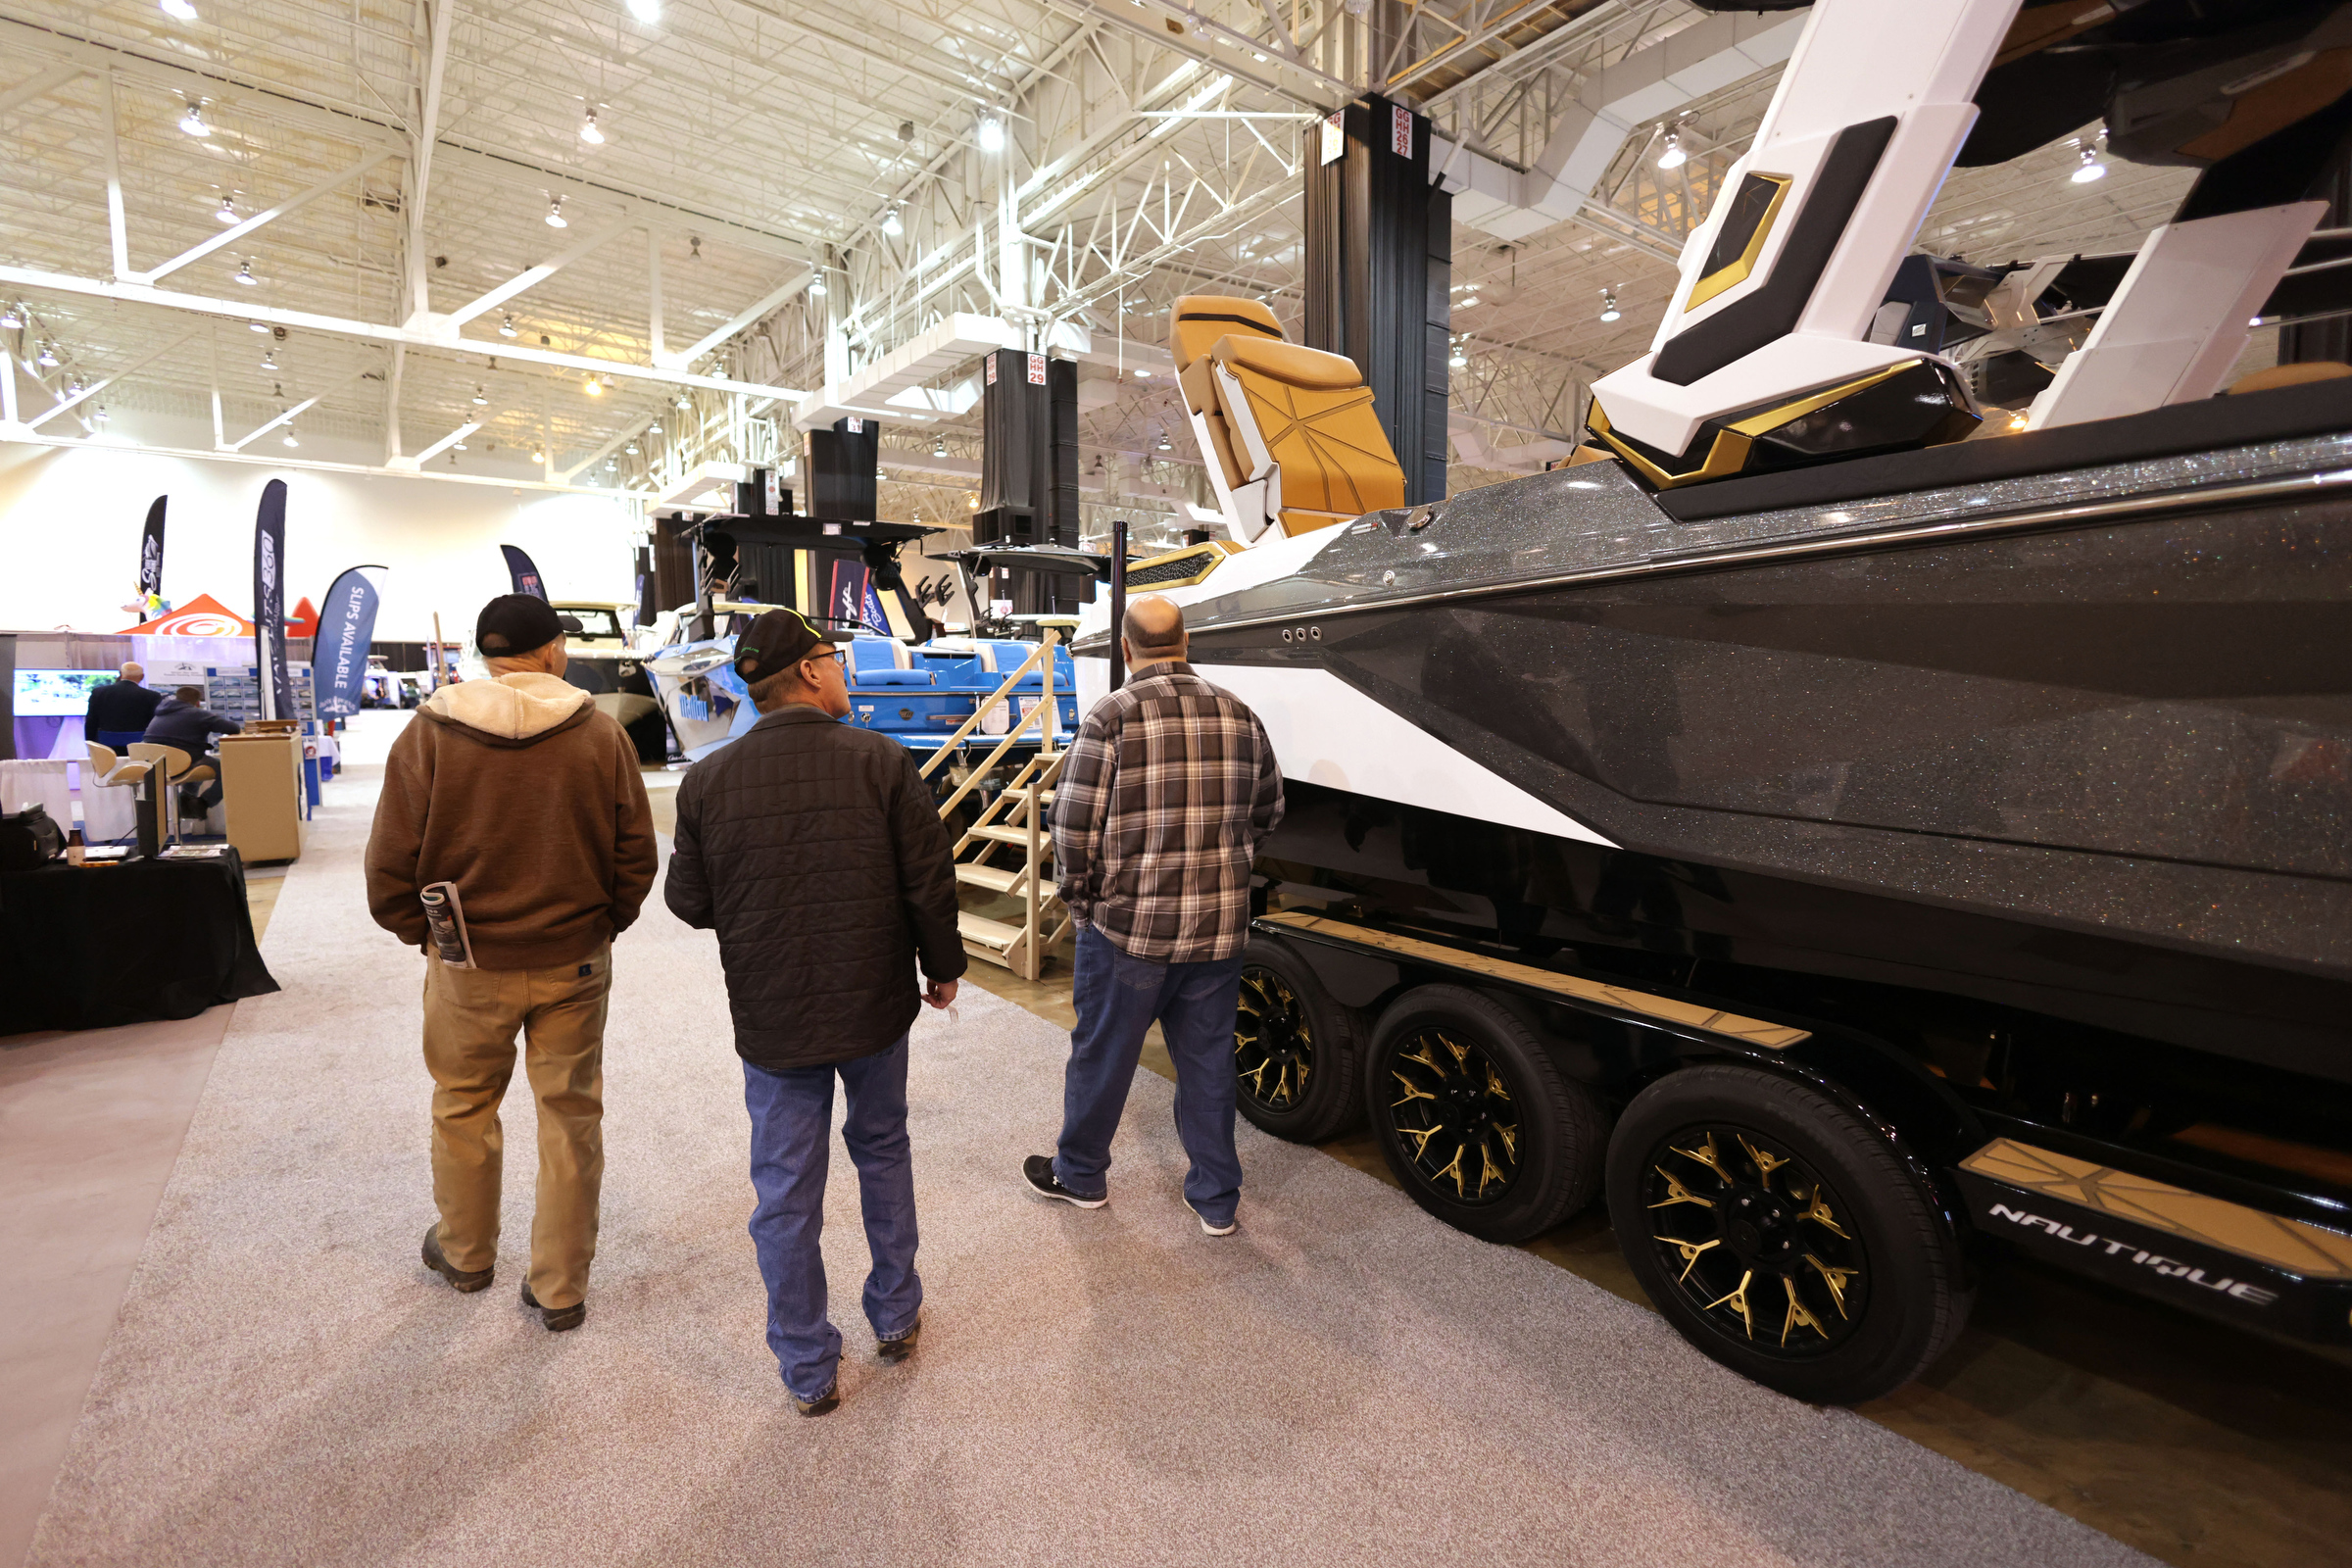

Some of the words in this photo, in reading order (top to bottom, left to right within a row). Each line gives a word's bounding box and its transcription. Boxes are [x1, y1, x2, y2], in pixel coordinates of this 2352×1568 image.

[1396, 108, 1409, 122] GG
[1396, 120, 1409, 134] HH
[1396, 131, 1408, 145] 26
[1396, 143, 1408, 156] 27
[1029, 355, 1044, 365] GG
[1029, 364, 1044, 372] HH
[1030, 372, 1044, 383] 29
[346, 585, 365, 620] SLIPS
[334, 620, 357, 689] AVAILABLE
[1988, 1203, 2278, 1305] NAUTIQUE
